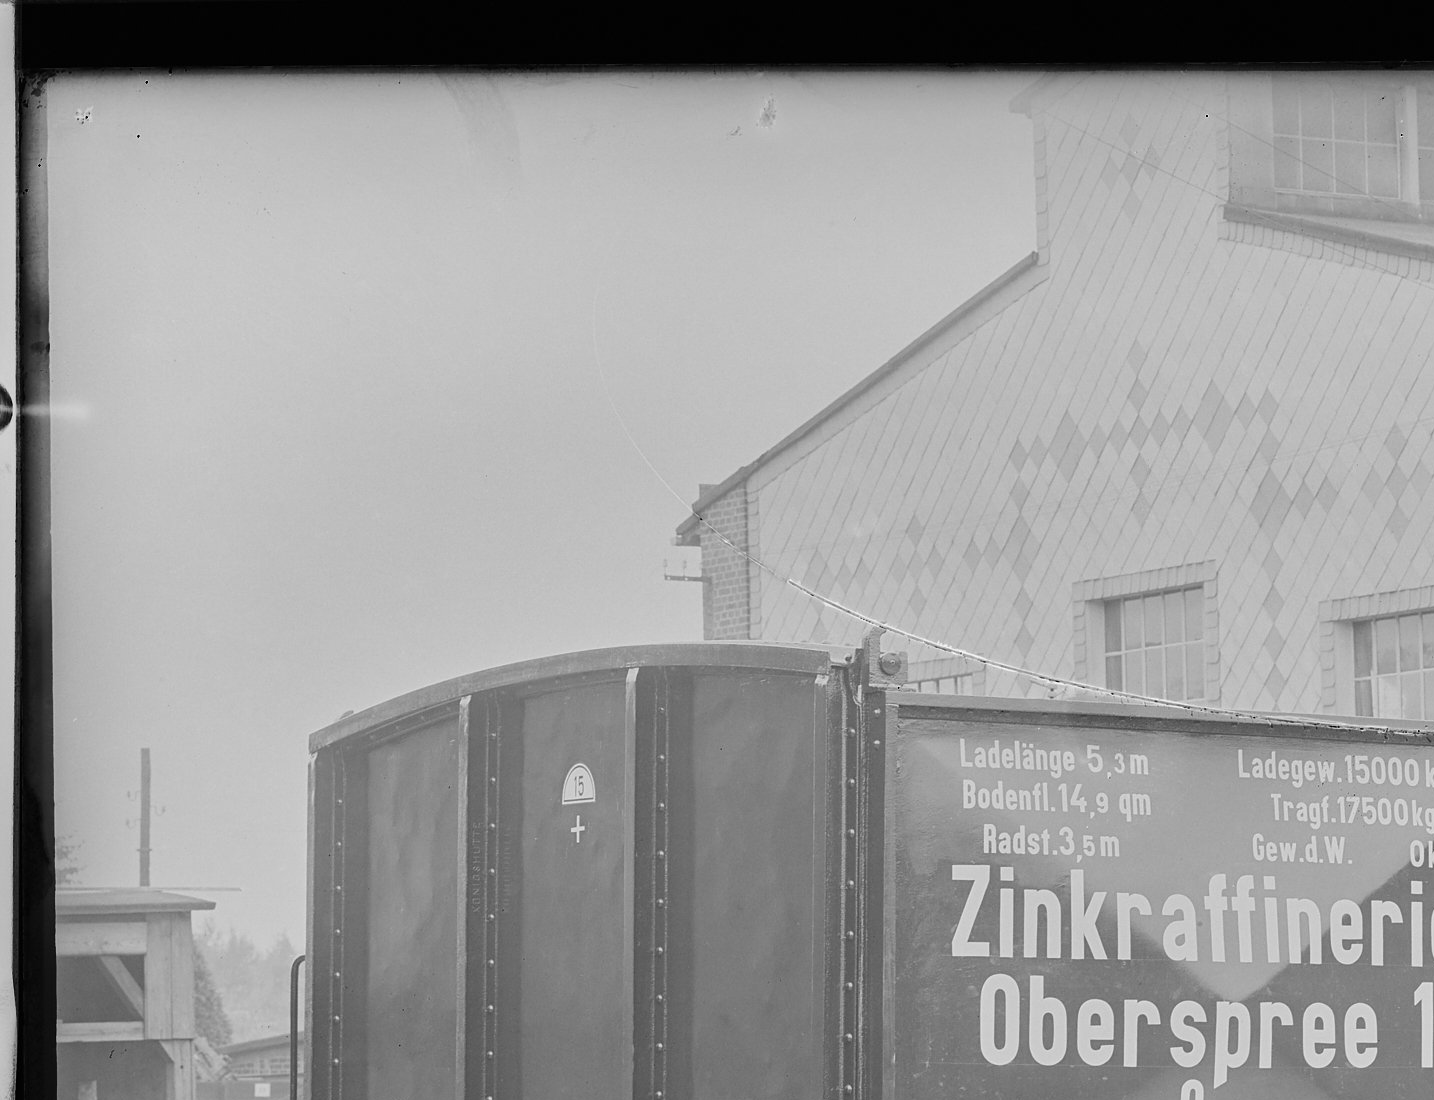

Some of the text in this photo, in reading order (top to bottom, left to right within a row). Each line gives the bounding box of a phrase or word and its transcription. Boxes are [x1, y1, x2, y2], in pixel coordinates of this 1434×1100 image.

[959, 738, 1076, 779] Ladelänge
[574, 775, 585, 797] 15
[1118, 793, 1151, 822] qm
[979, 973, 1434, 1089] Oberspree 1
